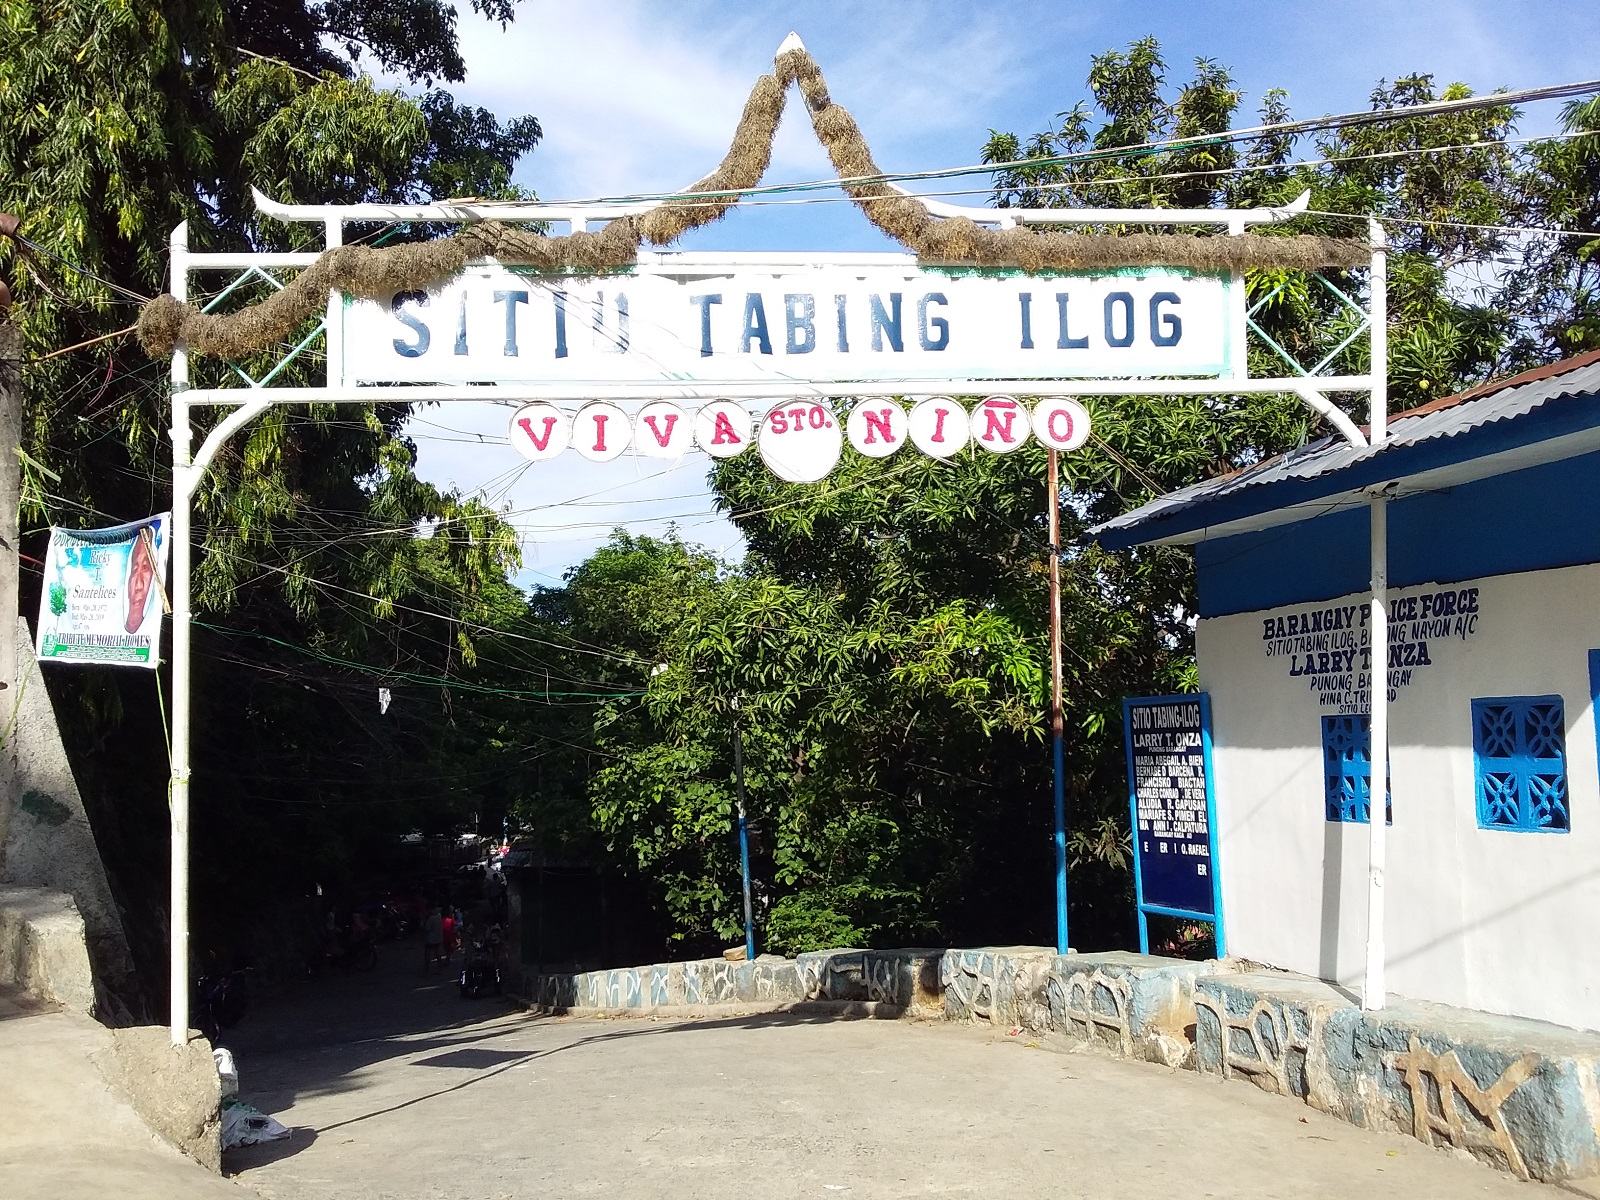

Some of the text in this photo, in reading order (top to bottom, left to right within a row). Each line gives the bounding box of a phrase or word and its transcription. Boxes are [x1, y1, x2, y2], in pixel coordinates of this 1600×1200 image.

[392, 290, 1183, 358] SITIO TABING ILOG
[518, 401, 1074, 452] VIVA STO. NIÑO
[89, 550, 112, 566] Ricky
[73, 585, 117, 599] Santelices
[1263, 606, 1357, 640] BARANGAY
[1420, 588, 1479, 619] FORCE
[58, 633, 150, 647] TRIBUTE MEMORIAL HOMES
[1267, 639, 1293, 656] SITIO
[1294, 634, 1329, 653] TABING
[1412, 618, 1451, 640] NAYON
[1455, 614, 1479, 640] A/C
[1290, 649, 1357, 676] LARRY
[1310, 674, 1353, 692] PUNONG
[1320, 692, 1341, 706] HINA
[1339, 704, 1358, 714] SITIO
[1132, 707, 1151, 729] SITIO
[1134, 732, 1202, 747] LARRY T. ONZA
[1135, 755, 1154, 766] MARIA
[1155, 755, 1180, 766] ABEGAIL
[1181, 755, 1188, 766] A.
[1168, 766, 1194, 777] BARCENA
[1136, 777, 1171, 788] FRANCISKO
[1137, 788, 1205, 799] CHARLES CONRAD DE VERA
[1138, 799, 1206, 811] ALUDIA R. GAPUSAN
[1138, 809, 1167, 820] MARIAFE
[1173, 822, 1208, 834] CALPATURA
[1160, 842, 1168, 854] ER
[1188, 844, 1209, 856] RAFAEL
[1197, 864, 1207, 876] ER
